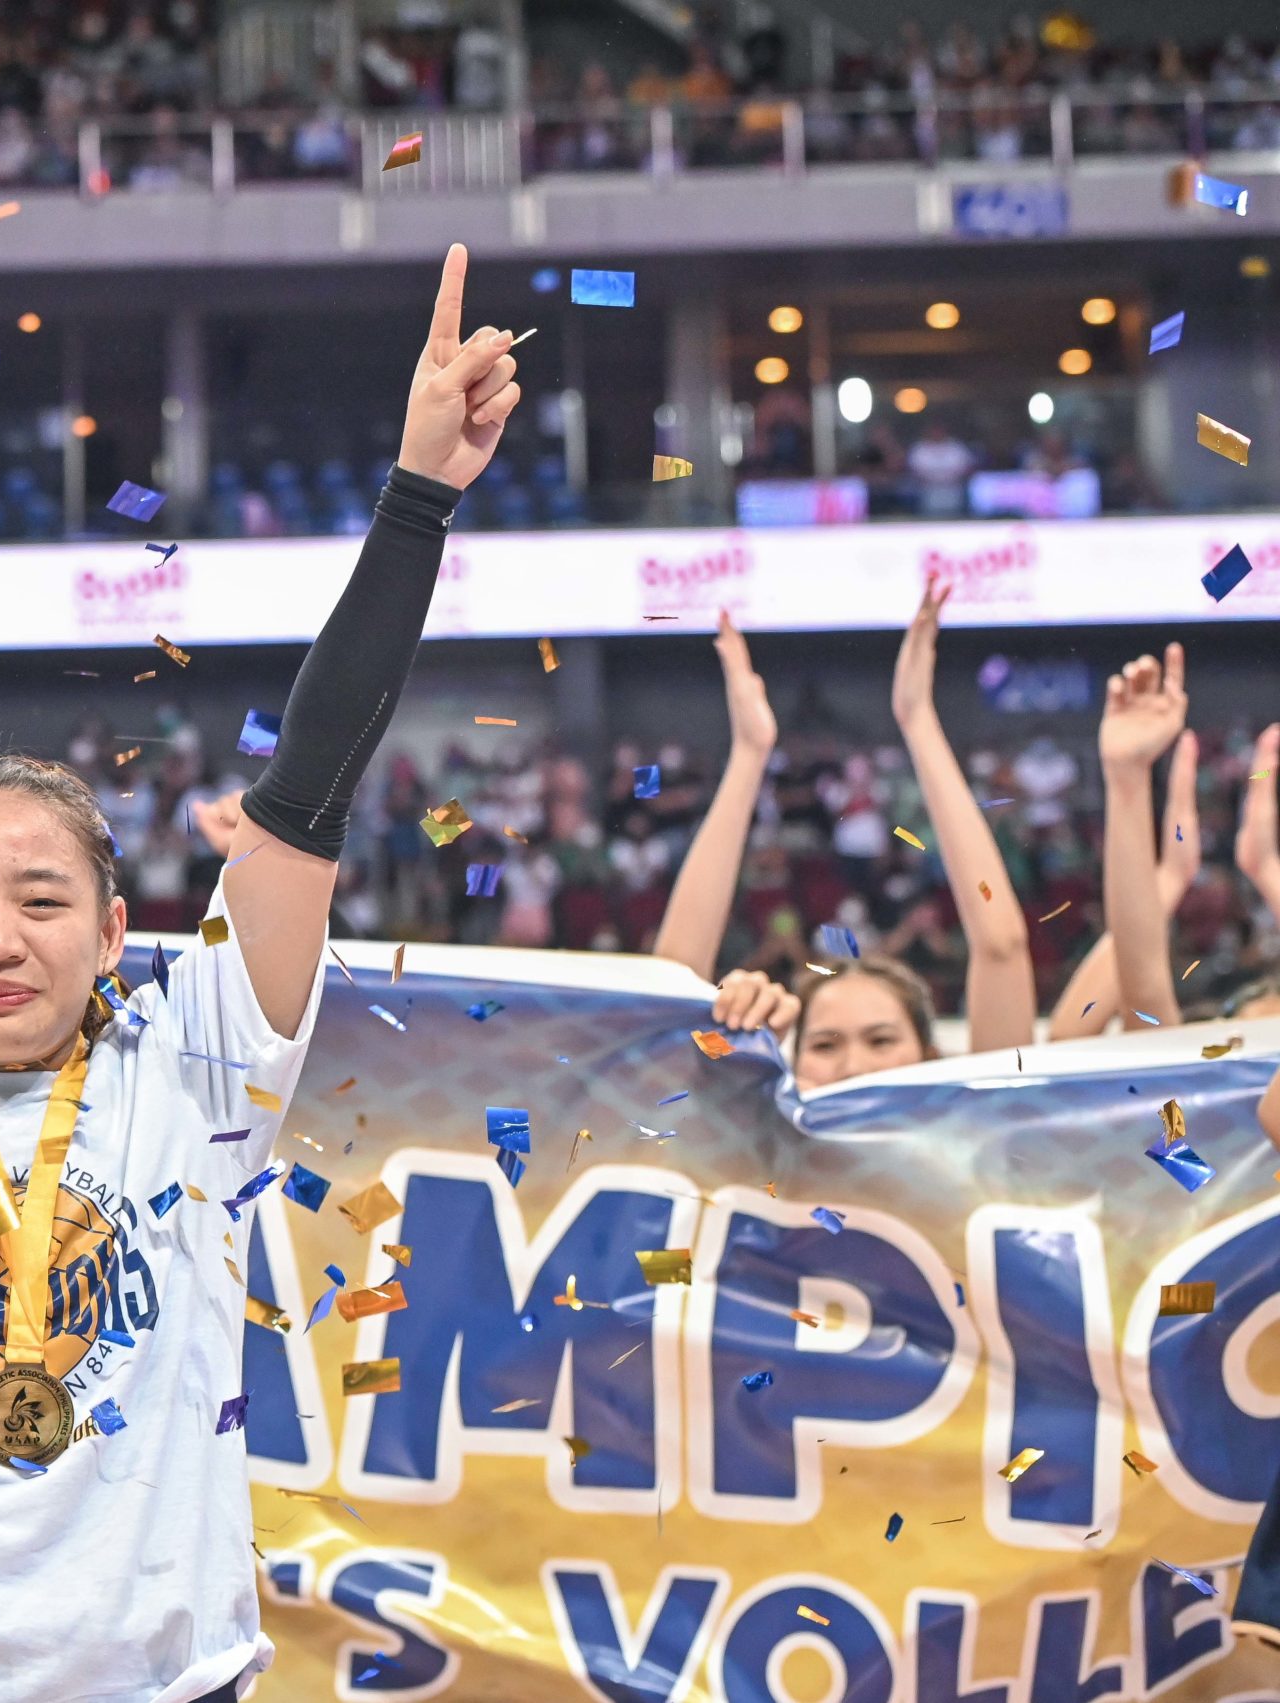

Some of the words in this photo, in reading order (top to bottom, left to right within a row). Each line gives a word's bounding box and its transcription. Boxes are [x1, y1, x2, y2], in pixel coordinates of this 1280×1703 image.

[12, 1161, 123, 1226] VYBALL
[86, 1342, 112, 1375] 84
[17, 1369, 61, 1394] ASSOCIATION
[58, 1392, 71, 1437] PHILIPPINES
